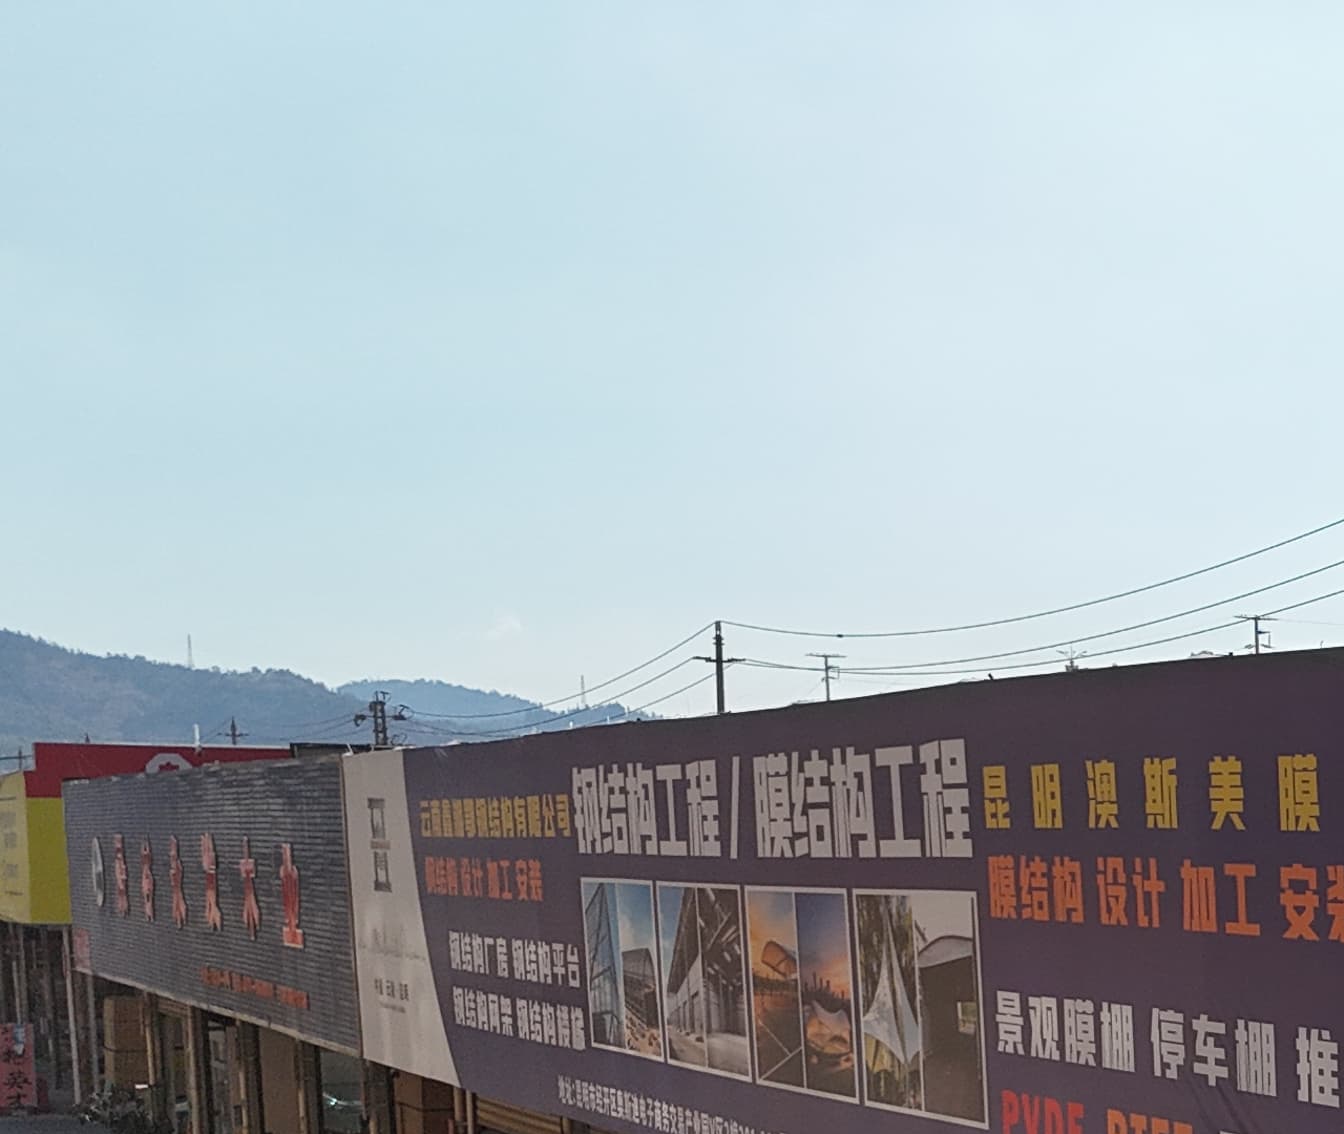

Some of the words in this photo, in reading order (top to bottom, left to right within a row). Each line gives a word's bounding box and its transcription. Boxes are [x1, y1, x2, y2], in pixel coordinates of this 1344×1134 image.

[995, 989, 1136, 1072] 景观膜棚
[1150, 1006, 1278, 1097] 停车棚
